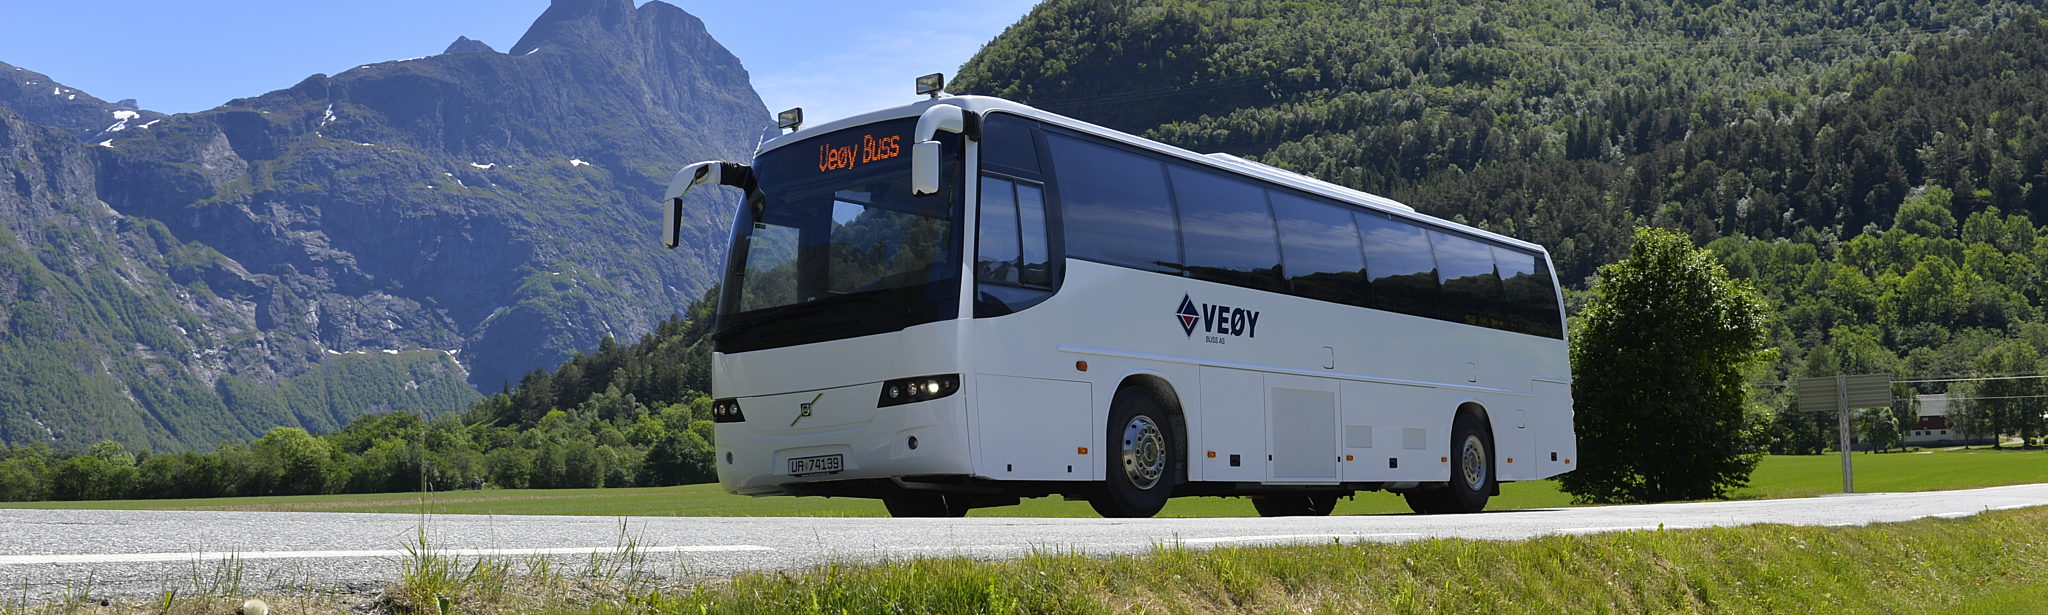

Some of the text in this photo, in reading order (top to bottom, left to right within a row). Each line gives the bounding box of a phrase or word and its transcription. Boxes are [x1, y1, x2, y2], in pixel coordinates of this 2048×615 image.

[819, 134, 901, 172] Veøy Buss
[1202, 303, 1260, 339] VEØY
[1205, 335, 1226, 345] BUSS AS
[809, 457, 839, 471] 74139
